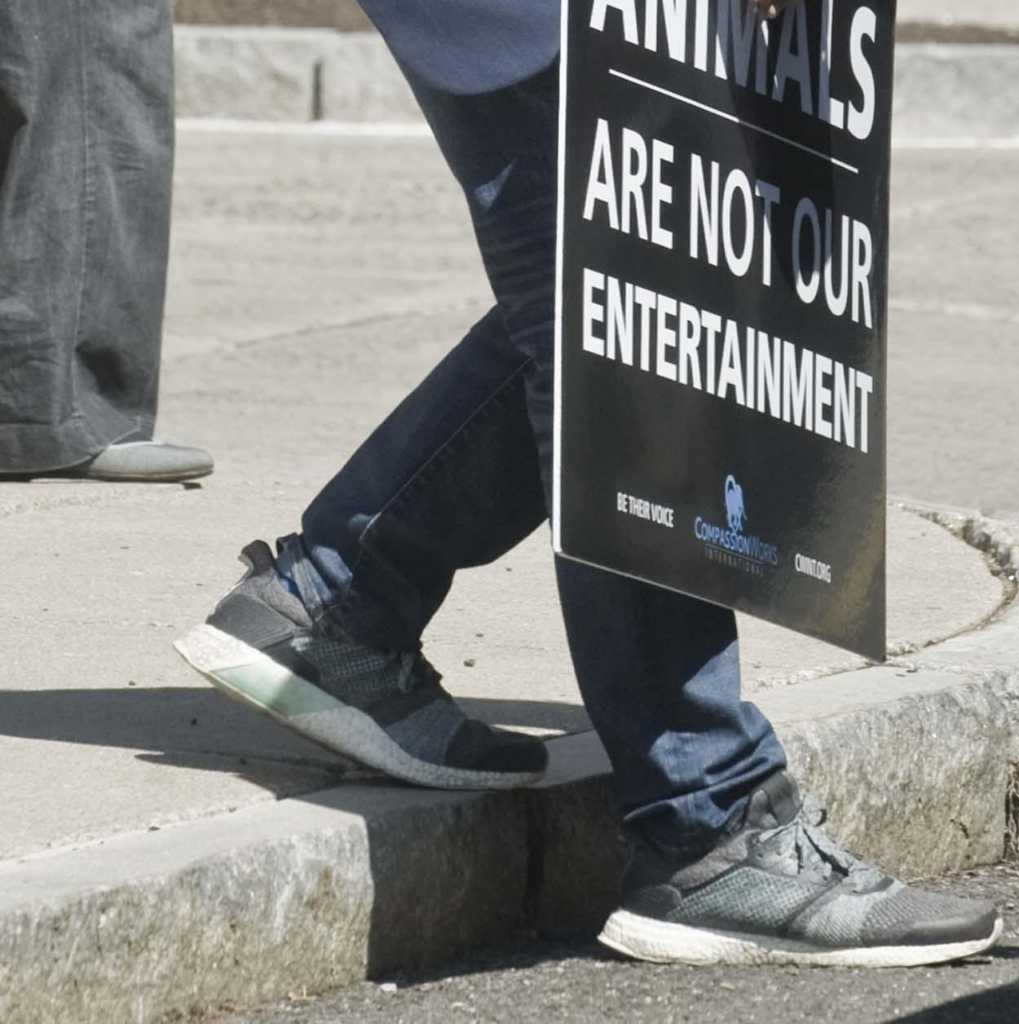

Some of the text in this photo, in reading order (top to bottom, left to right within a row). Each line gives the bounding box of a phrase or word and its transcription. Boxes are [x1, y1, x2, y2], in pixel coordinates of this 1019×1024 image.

[583, 117, 873, 329] ARE NOT OUR
[582, 267, 873, 454] ENTERTAINMENT
[617, 492, 674, 527] BE THEIR VOICE
